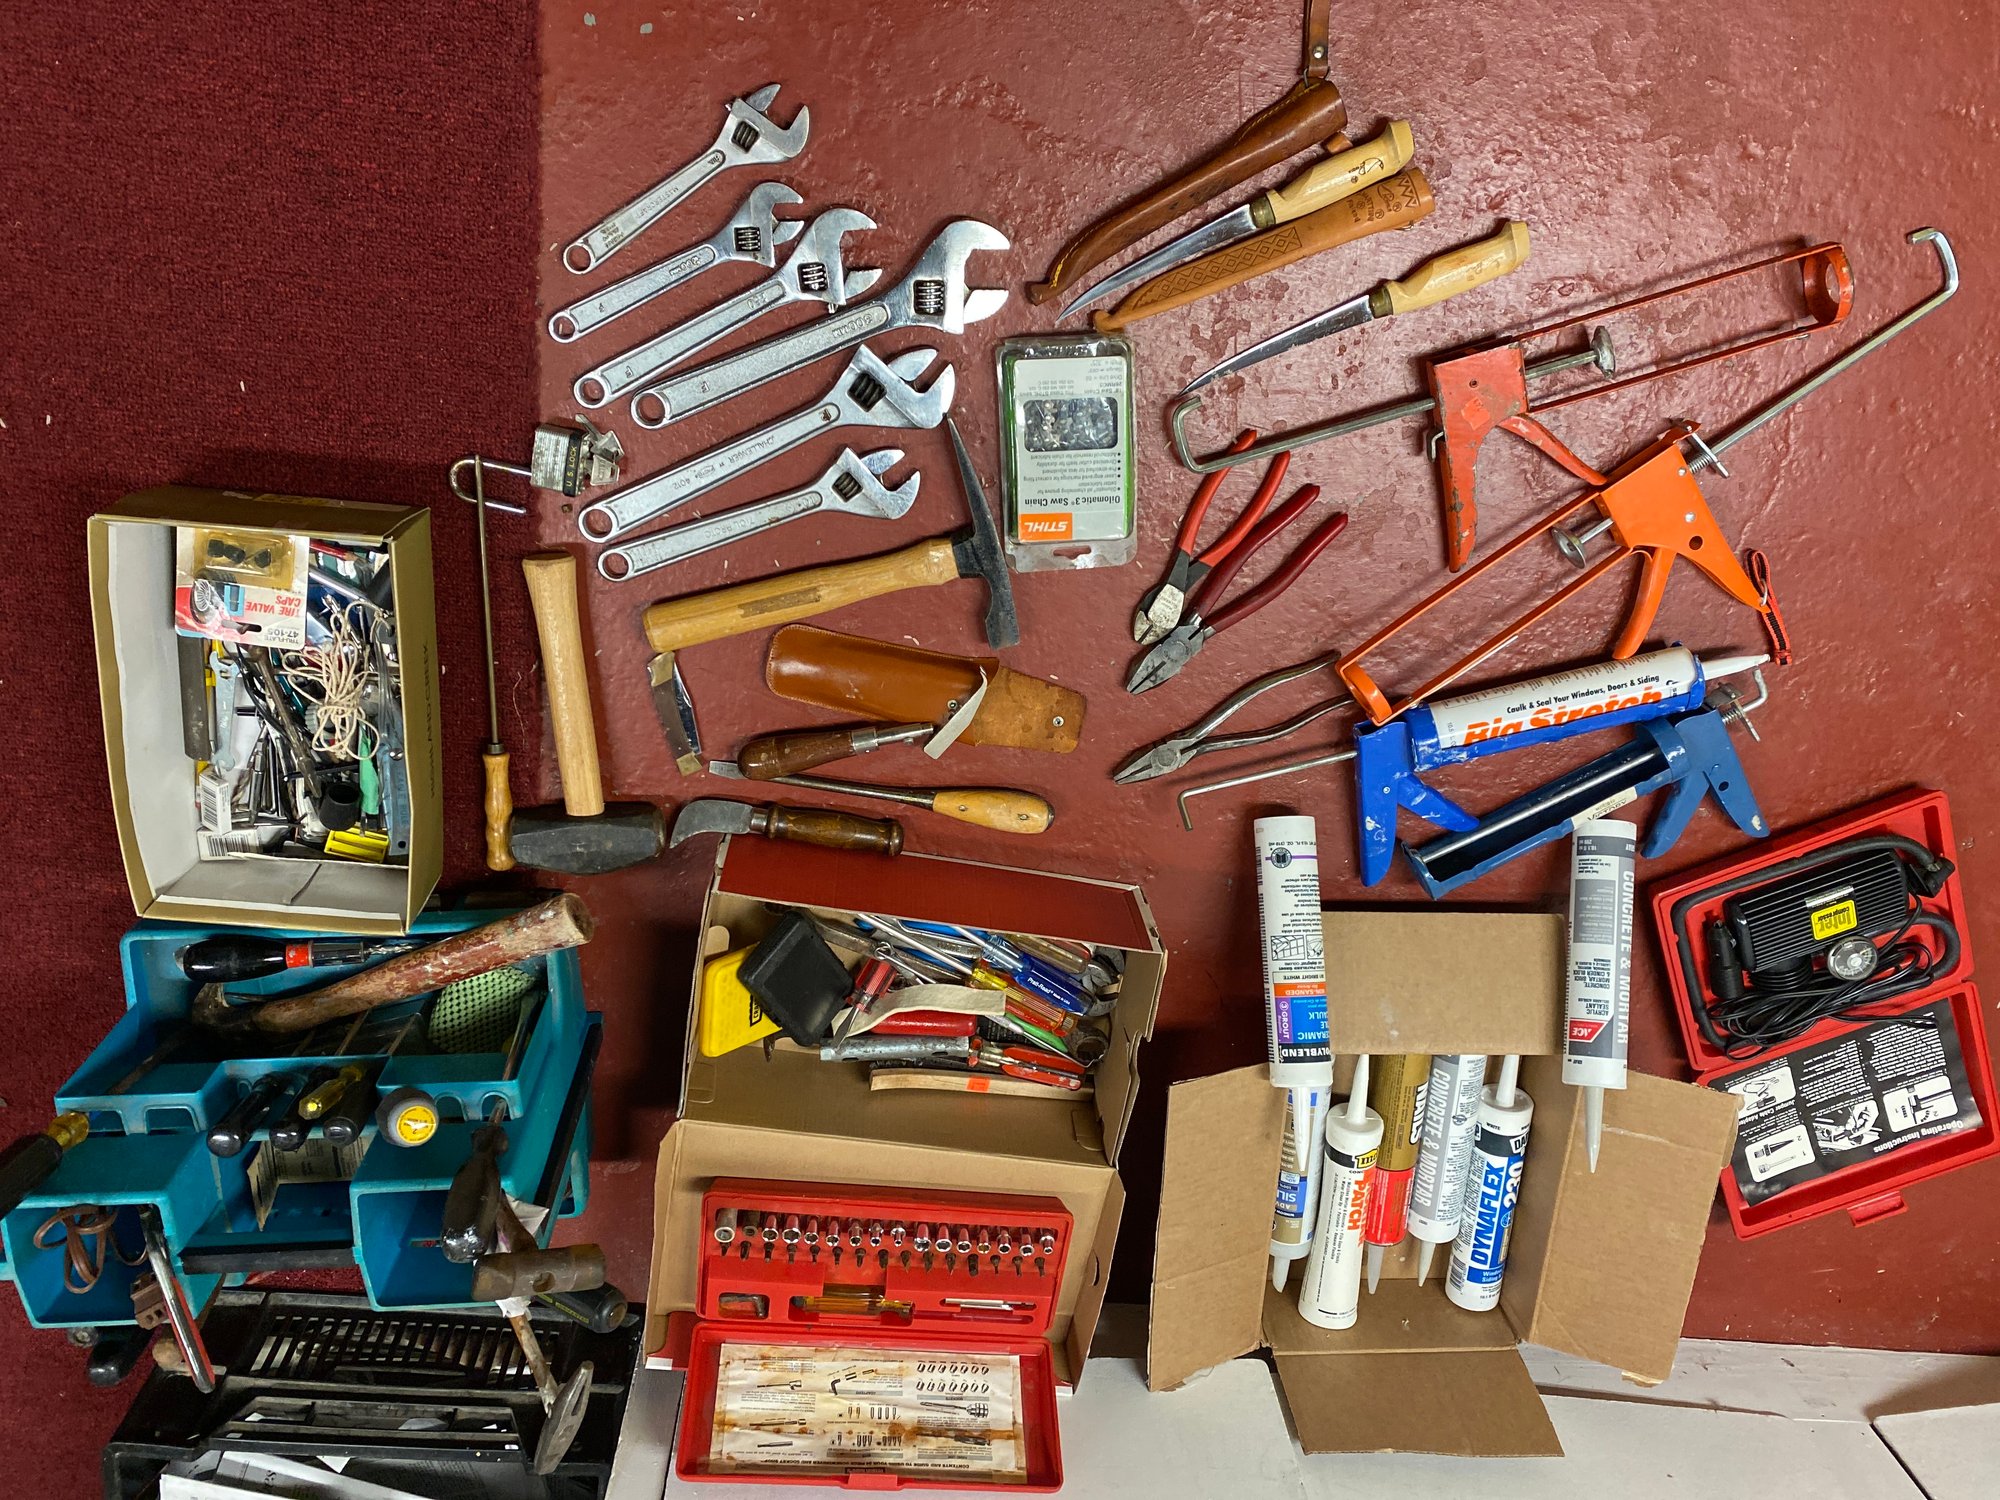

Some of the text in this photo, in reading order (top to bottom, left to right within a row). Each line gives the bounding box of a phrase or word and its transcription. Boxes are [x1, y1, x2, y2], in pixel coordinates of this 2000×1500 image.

[568, 445, 576, 466] LOCK
[727, 435, 775, 463] CHALLENGER
[1024, 495, 1120, 506] Oilomatic Saw Chain
[1023, 520, 1067, 532] STIHL
[244, 601, 299, 617] TIRE VALVE
[274, 595, 301, 607] CAPS
[266, 628, 298, 637] 47-105
[1506, 672, 1659, 713] Caulk & Seal Your Windows, Doors & Siding
[1817, 906, 1849, 921] compressor
[1616, 870, 1634, 1043] CONCRETE & MORTAR
[1281, 1011, 1289, 1038] GROUT
[1571, 1027, 1591, 1036] ACE
[1297, 1030, 1328, 1039] ERAMIC
[1758, 1107, 1774, 1117] Cable
[1775, 1099, 1794, 1110] Jumper
[1417, 1068, 1451, 1208] CONCRETE & MORTAR
[1873, 1120, 1963, 1153] Operating Instructions
[1503, 1161, 1525, 1208] 230
[1348, 1180, 1367, 1230] PATCH
[1470, 1161, 1506, 1266] DYNAFLEX
